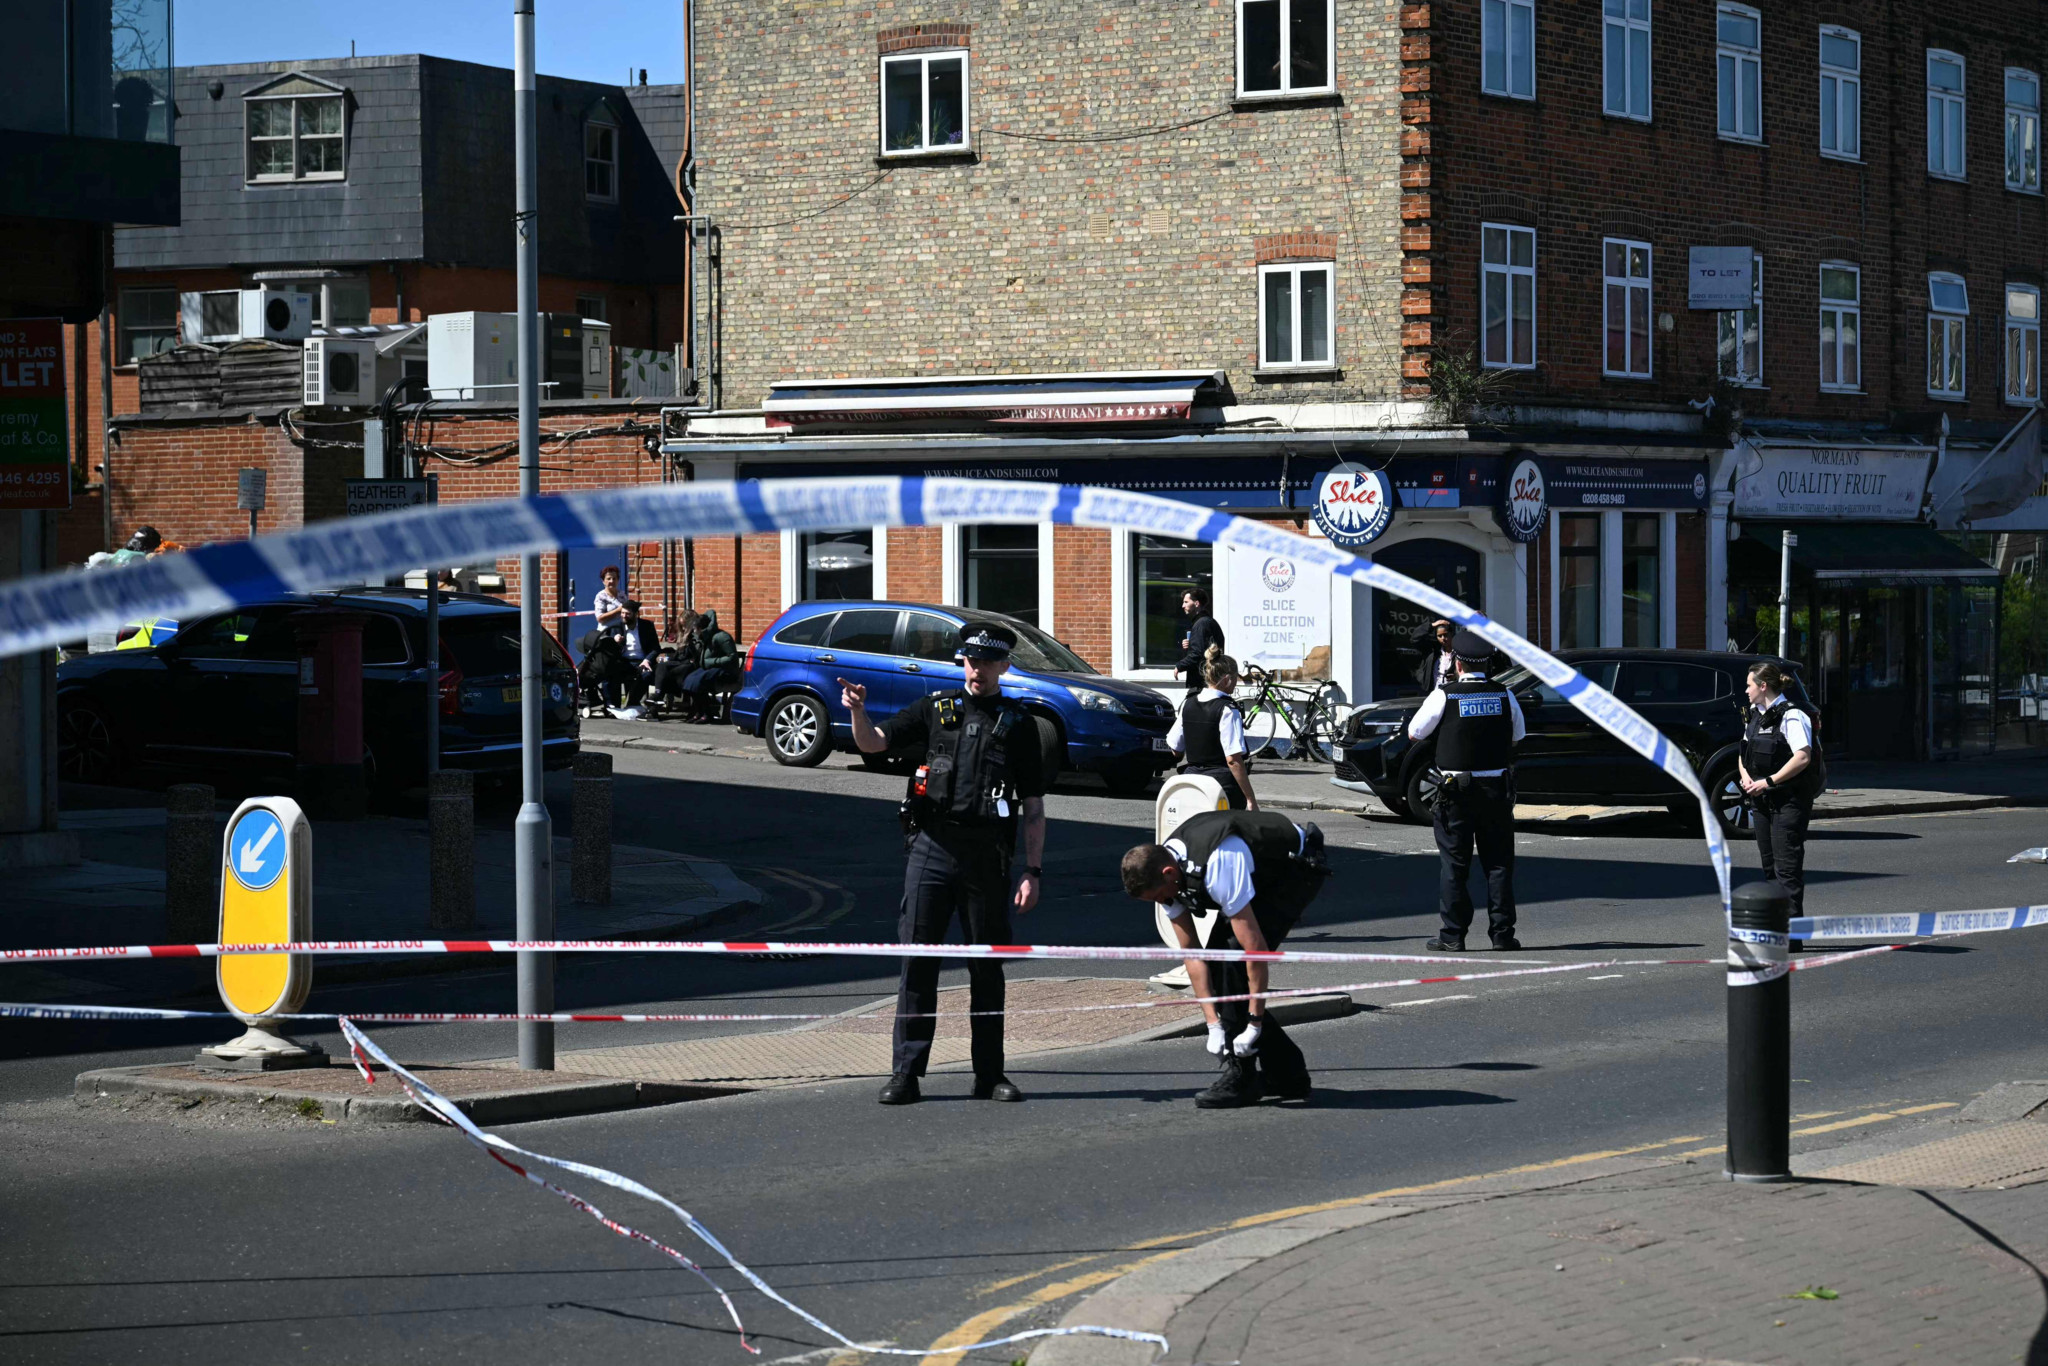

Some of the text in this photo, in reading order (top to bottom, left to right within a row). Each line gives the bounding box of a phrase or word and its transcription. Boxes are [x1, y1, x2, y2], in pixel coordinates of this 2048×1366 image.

[1700, 269, 1741, 277] TO LET
[19, 332, 27, 343] 2
[18, 346, 57, 358] FLATS
[2, 361, 54, 387] LET
[1026, 406, 1103, 419] RESTAURANT
[22, 431, 32, 445] &
[36, 430, 61, 445] Co.
[924, 468, 1058, 479] WWW.SLICEANDSUSHI.COM
[1565, 466, 1643, 478] WWW.SLICEANDSUSHI.COM
[27, 472, 61, 485] 4295
[1777, 471, 1842, 498] QUALITY
[1843, 473, 1885, 496] FRUIT
[348, 485, 406, 499] HEATHER
[1328, 480, 1377, 505] Slice
[1513, 478, 1540, 502] Slice
[1582, 494, 1624, 504] 0208 458 9483
[1315, 514, 1336, 541] TASTE
[1338, 536, 1349, 545] OF
[1353, 532, 1373, 545] NEW
[1374, 505, 1389, 532] YORK
[1269, 565, 1289, 576] Slice
[1262, 600, 1296, 611] SLICE
[1243, 616, 1315, 627] COLLECTION
[1263, 632, 1295, 643] ZONE
[1461, 703, 1501, 715] POLICE
